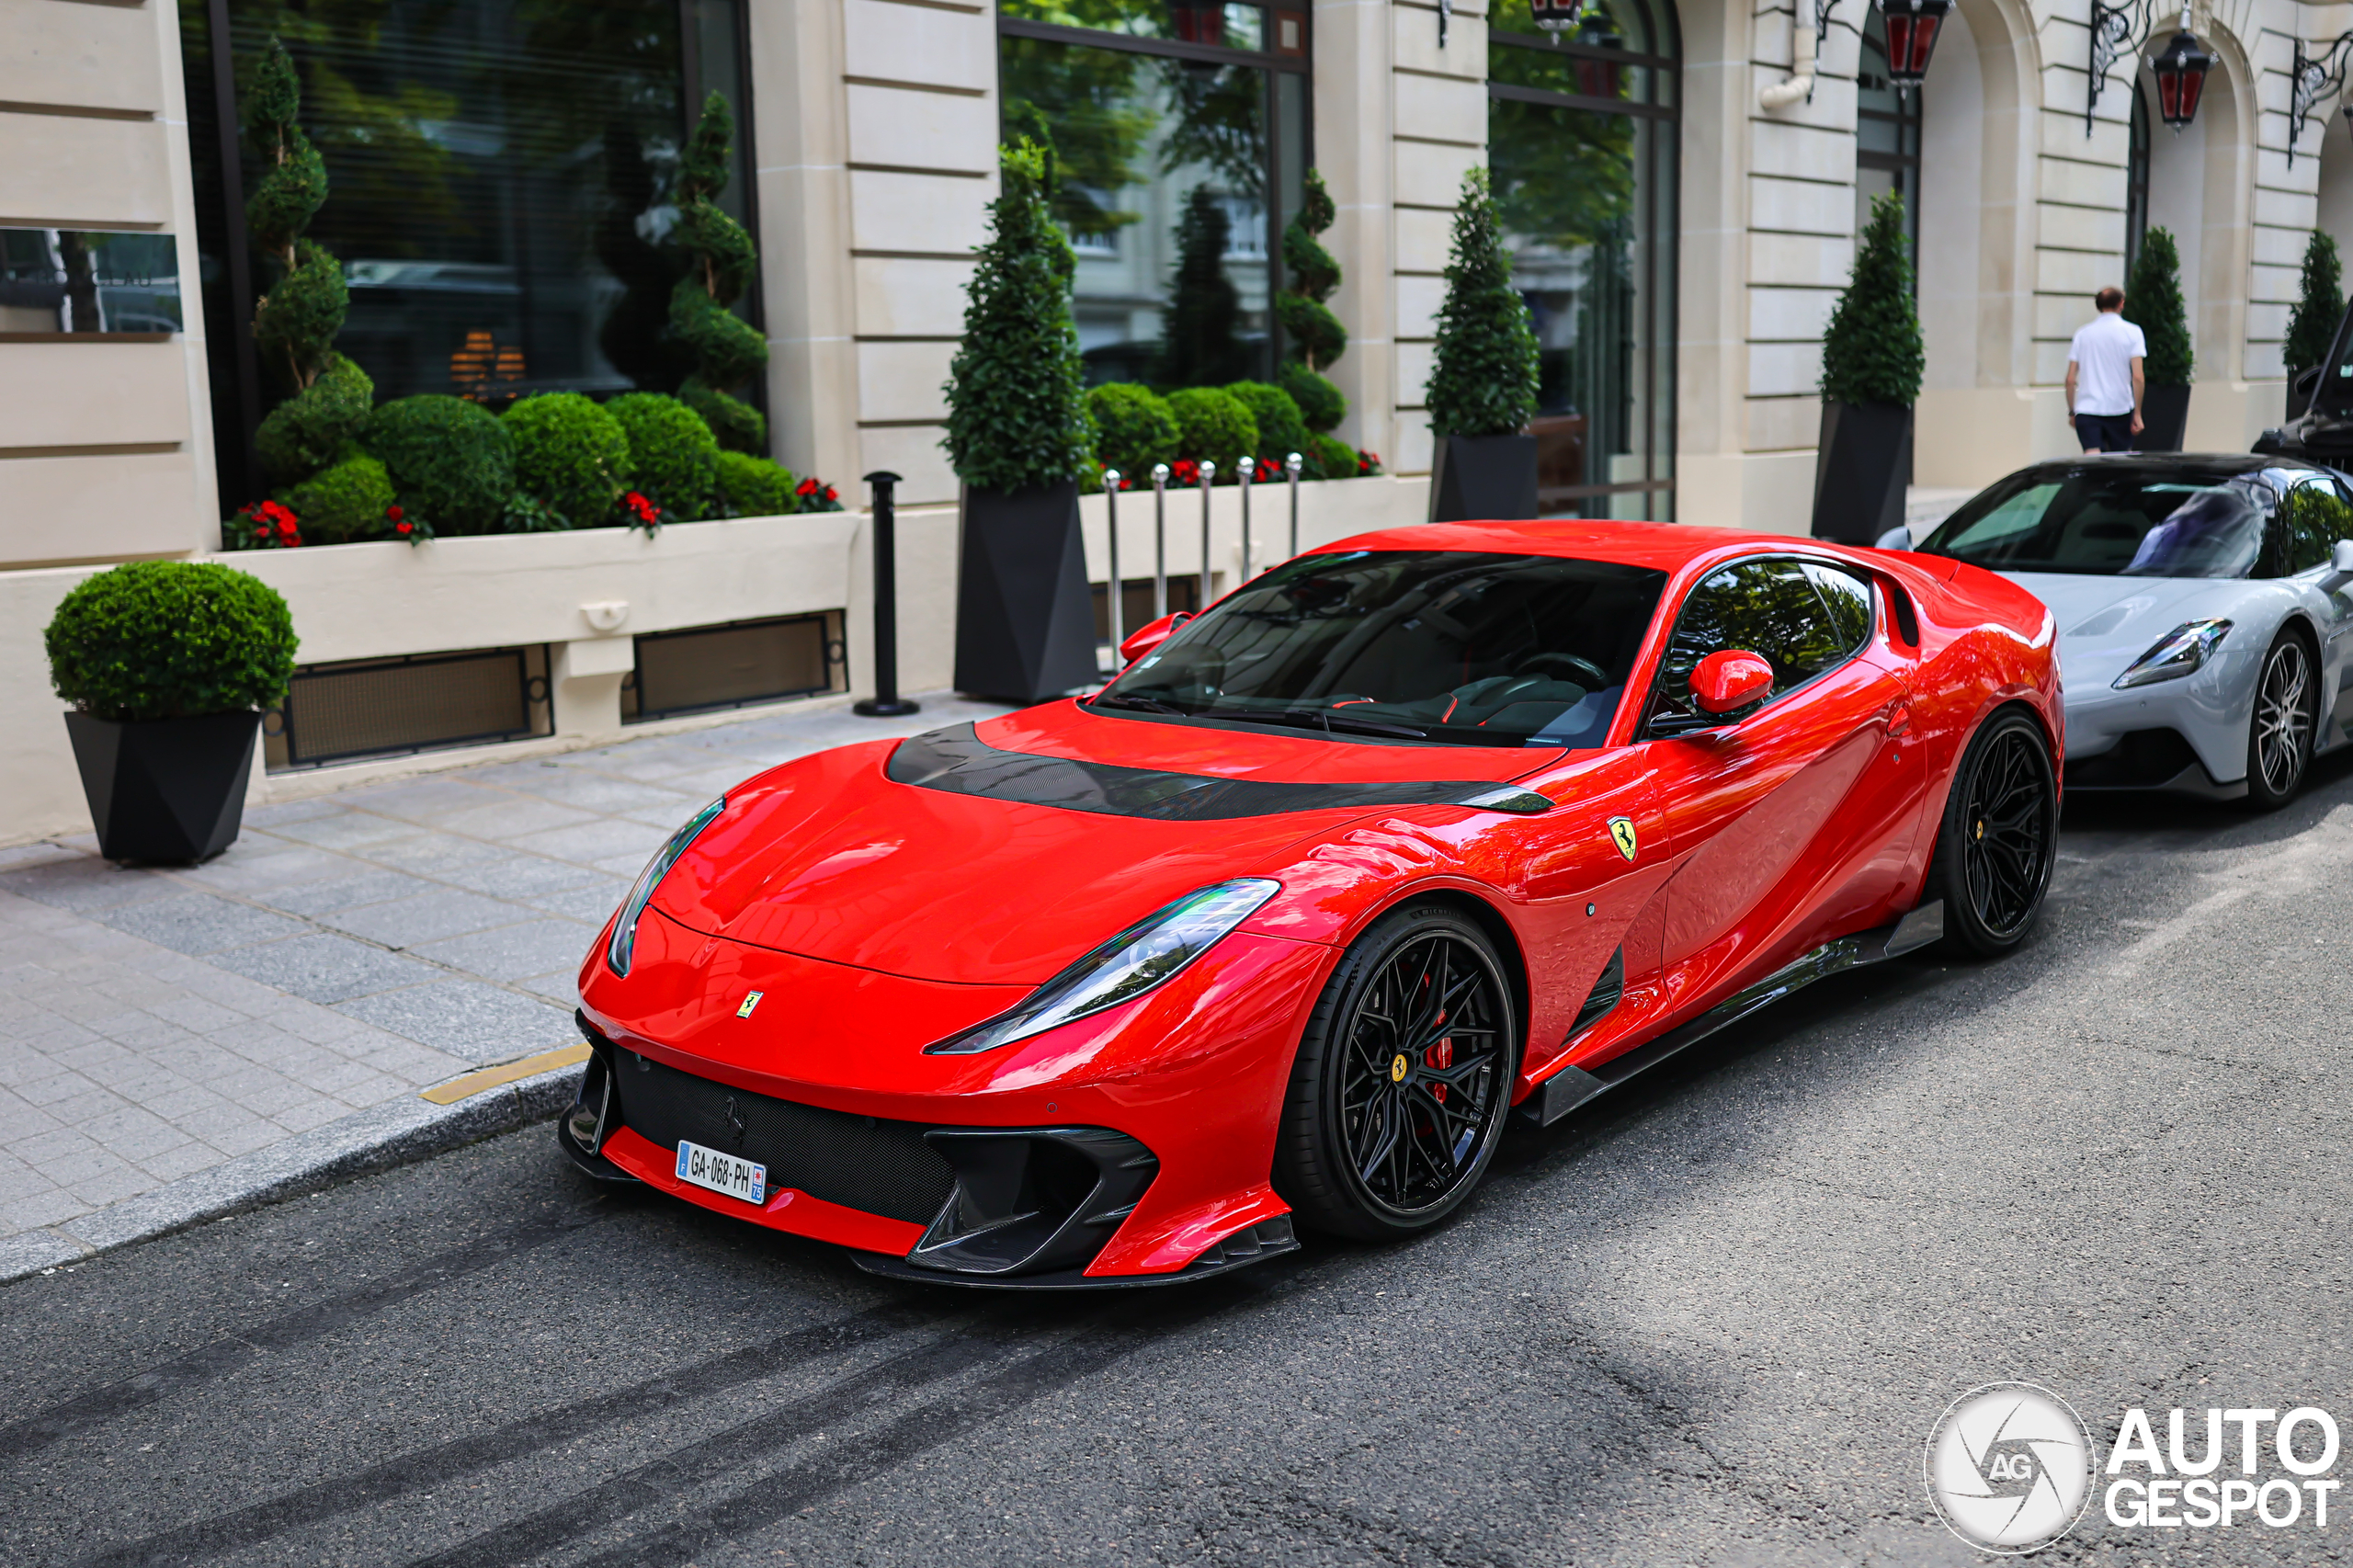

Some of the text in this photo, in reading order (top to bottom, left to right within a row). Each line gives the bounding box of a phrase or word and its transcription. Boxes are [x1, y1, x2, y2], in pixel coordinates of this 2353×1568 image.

[681, 1149, 761, 1199] F GA-068-PH 75
